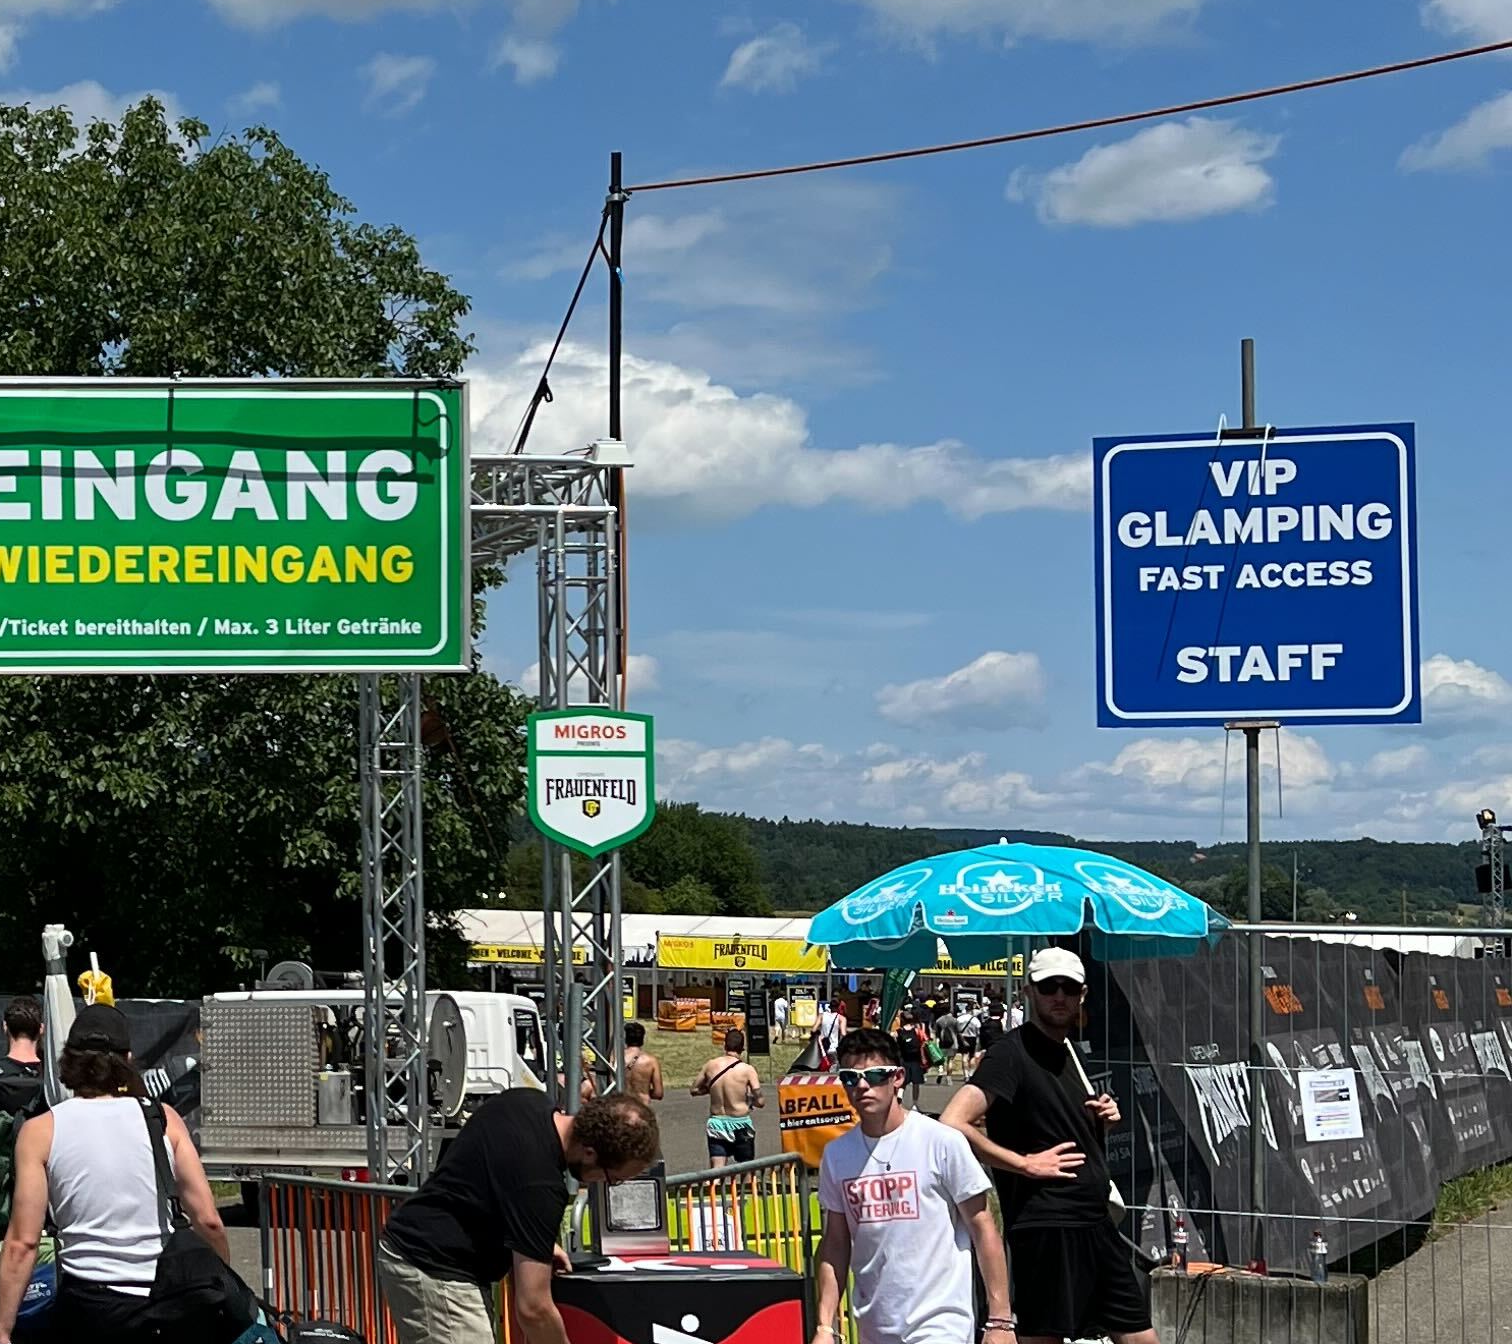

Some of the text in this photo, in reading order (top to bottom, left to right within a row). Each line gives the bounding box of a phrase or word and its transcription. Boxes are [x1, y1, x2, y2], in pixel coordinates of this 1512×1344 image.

[1209, 459, 1297, 497] VIP
[1118, 503, 1392, 548] GLAMPING
[1139, 560, 1372, 591] FAST ACCESS
[74, 618, 191, 636] bereithalten
[214, 619, 259, 636] Max.
[265, 619, 279, 636] 3
[285, 618, 331, 635] Liter
[336, 617, 422, 637] Getränke
[1176, 644, 1343, 684] STAFF
[555, 725, 627, 739] MIGROS
[545, 778, 636, 806] FRAUENFELD
[938, 880, 1063, 896] Heineken
[980, 892, 1063, 904] SILVER
[497, 948, 532, 959] WELCOME
[787, 1118, 804, 1127] hier
[805, 1115, 851, 1126] entsorgen
[847, 1176, 912, 1205] STOPP
